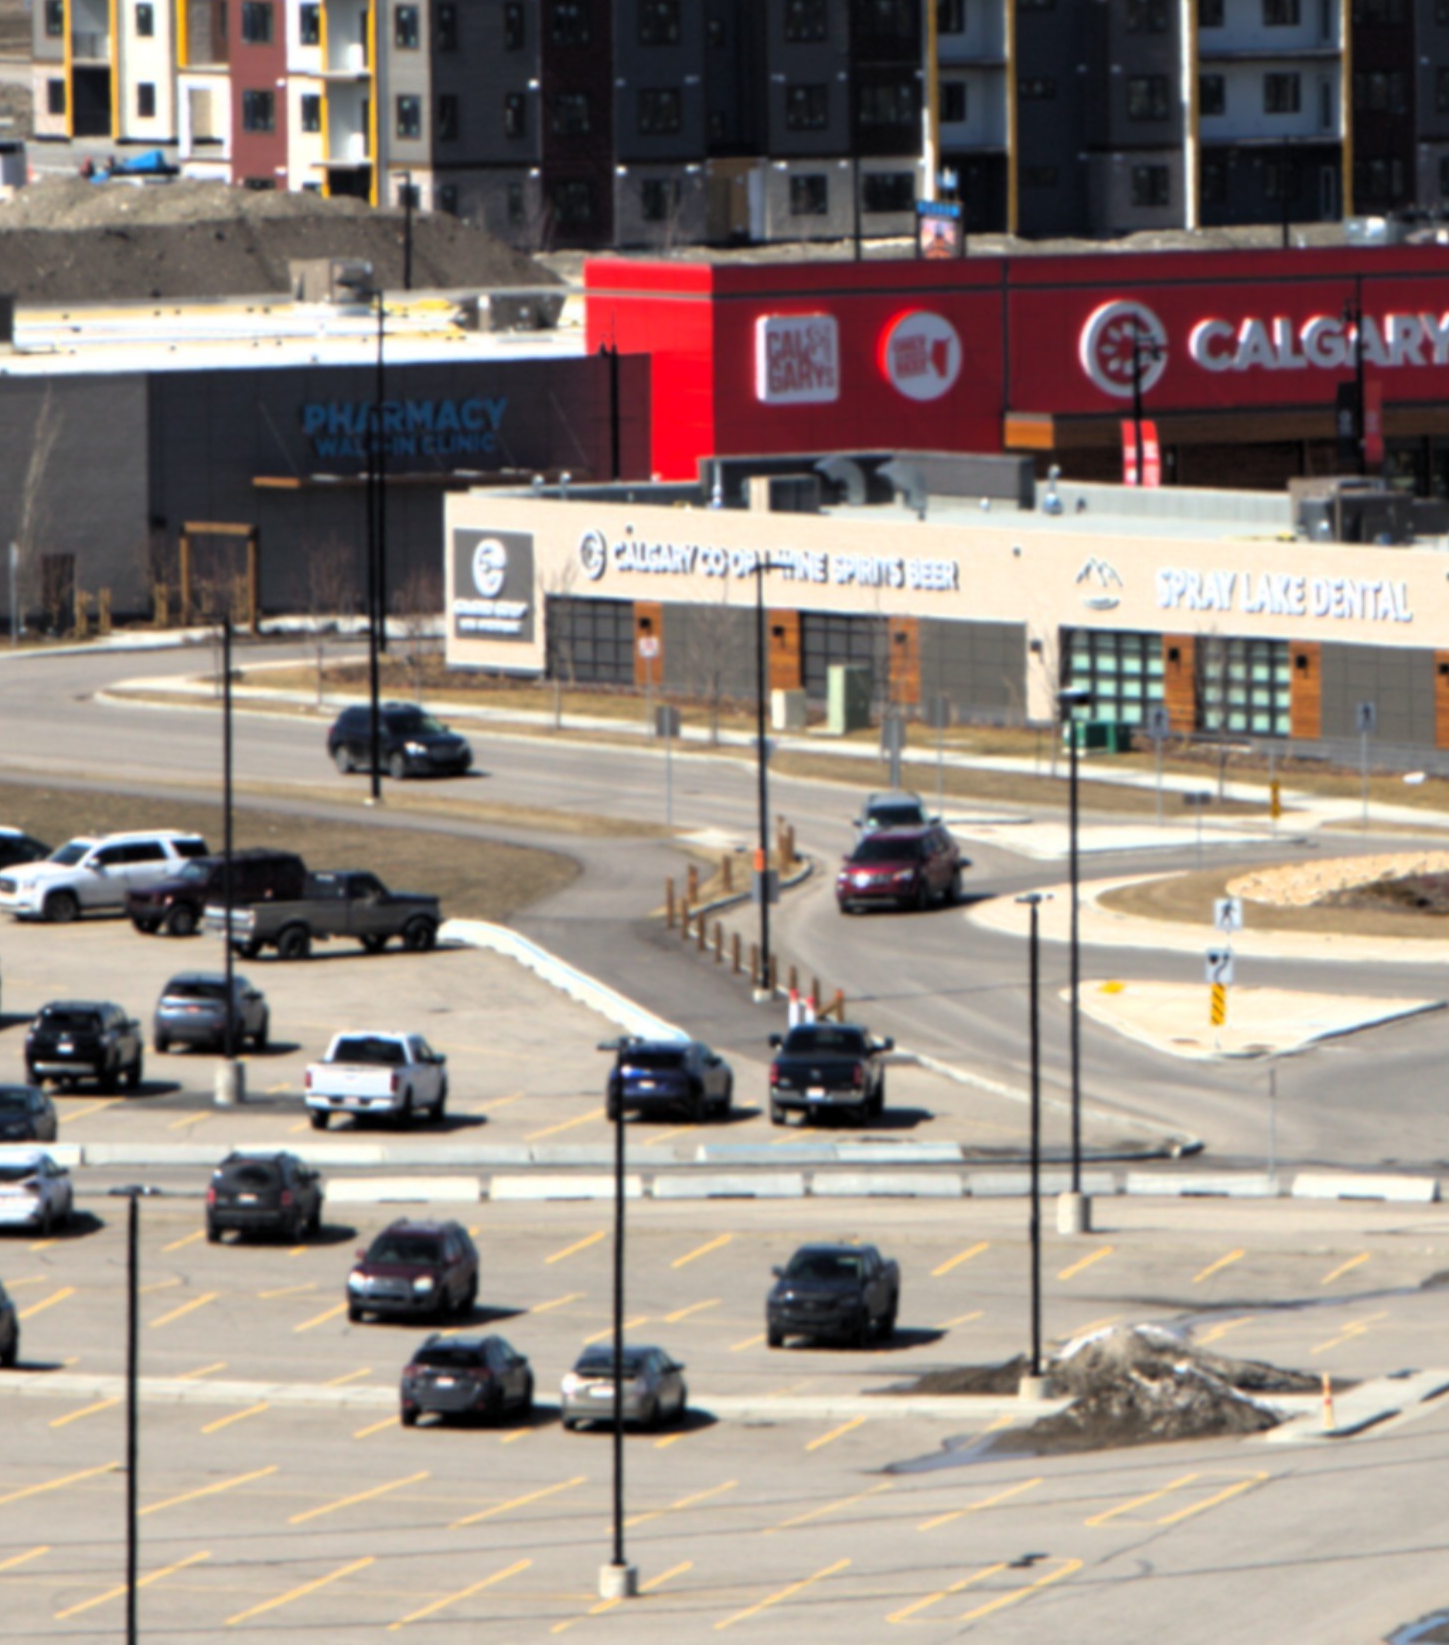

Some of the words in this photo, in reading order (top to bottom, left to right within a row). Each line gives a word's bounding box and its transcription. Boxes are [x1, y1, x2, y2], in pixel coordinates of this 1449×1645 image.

[303, 396, 508, 435] PHARMACY
[421, 432, 495, 455] CLINIC
[614, 542, 697, 574] CALGARY
[834, 555, 905, 588] SPIRITS
[911, 560, 962, 591] BEER
[1156, 567, 1238, 611] SPRAY
[1240, 571, 1307, 616] LAKE
[1311, 577, 1415, 623] DENTAL
